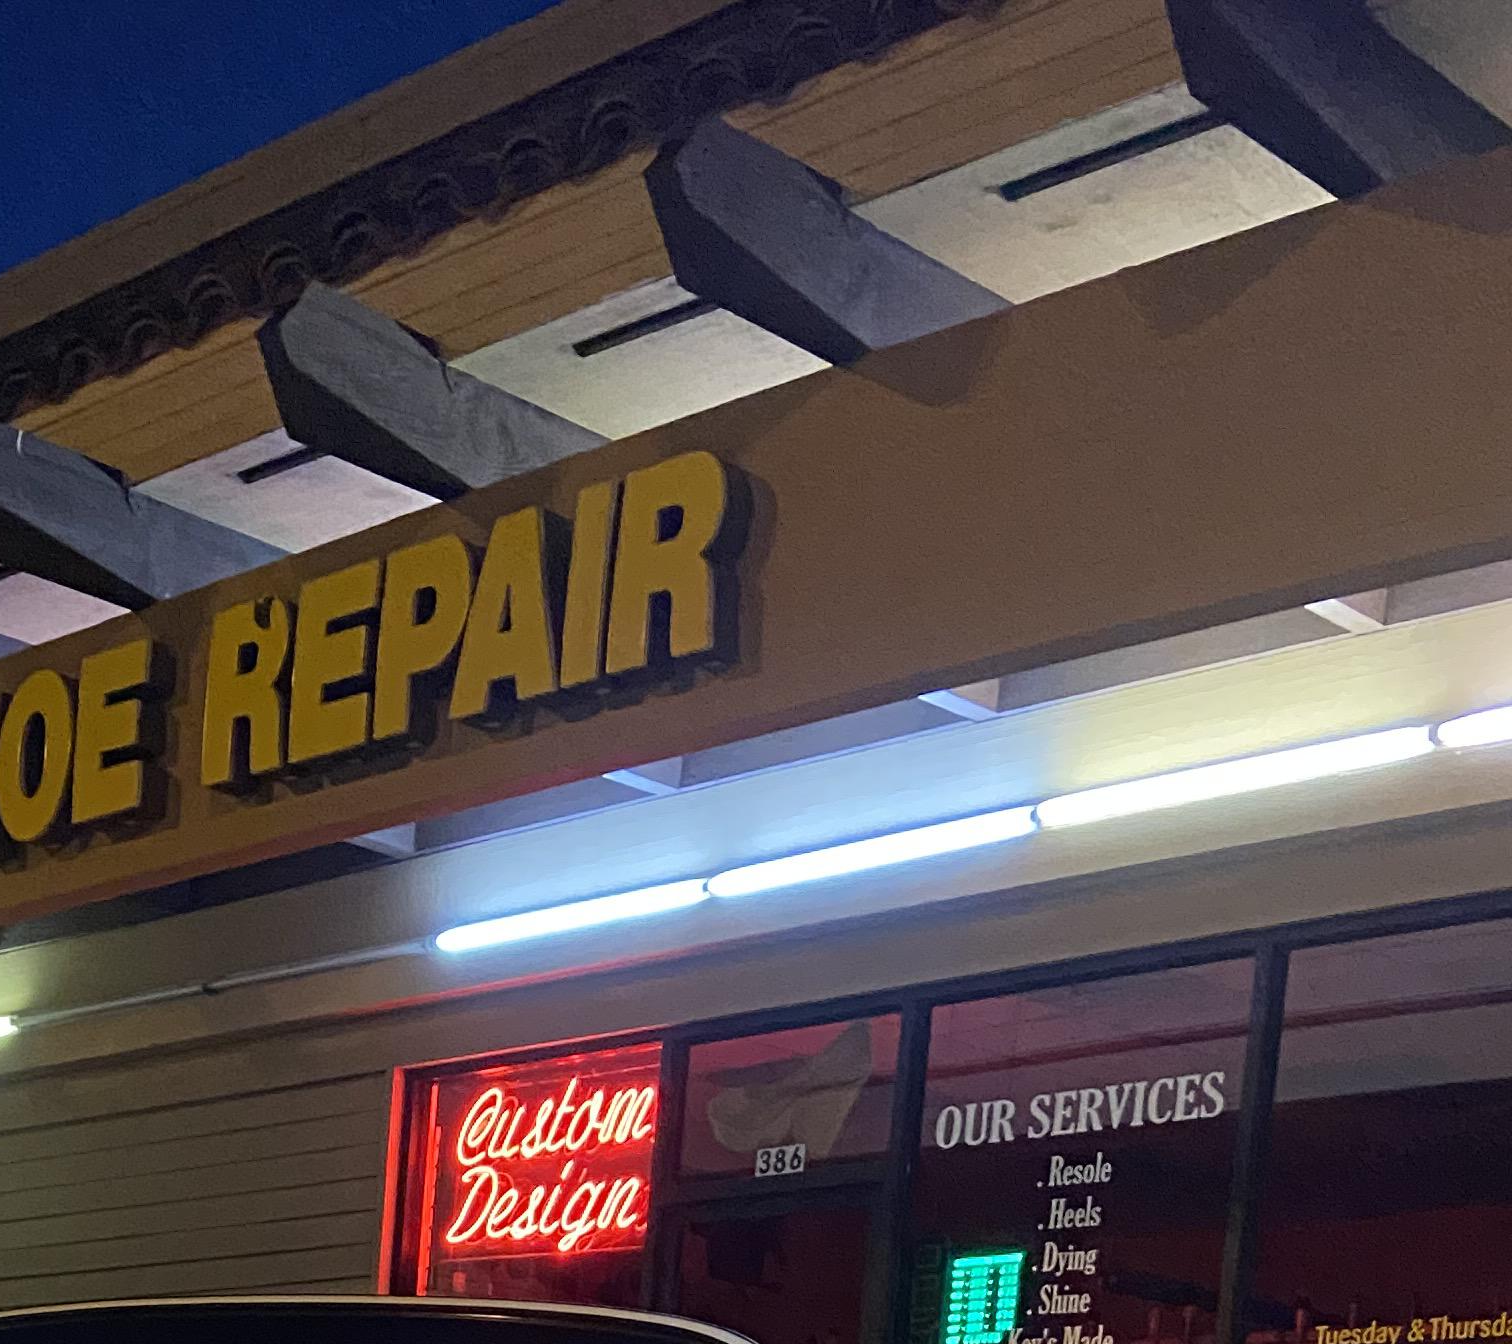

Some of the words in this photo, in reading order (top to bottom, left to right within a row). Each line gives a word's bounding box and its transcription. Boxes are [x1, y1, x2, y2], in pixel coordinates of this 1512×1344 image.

[201, 451, 728, 787] REPAIR
[457, 1076, 655, 1166] Custom
[935, 1099, 1016, 1149] OUR
[1027, 1071, 1225, 1140] SERVICES
[758, 1146, 802, 1174] 386
[1048, 1152, 1112, 1187] Resole
[446, 1159, 641, 1252] Design
[1048, 1196, 1102, 1229] Heels
[1041, 1241, 1098, 1277] Dying
[1038, 1284, 1091, 1314] Shine
[1407, 1318, 1425, 1343] &
